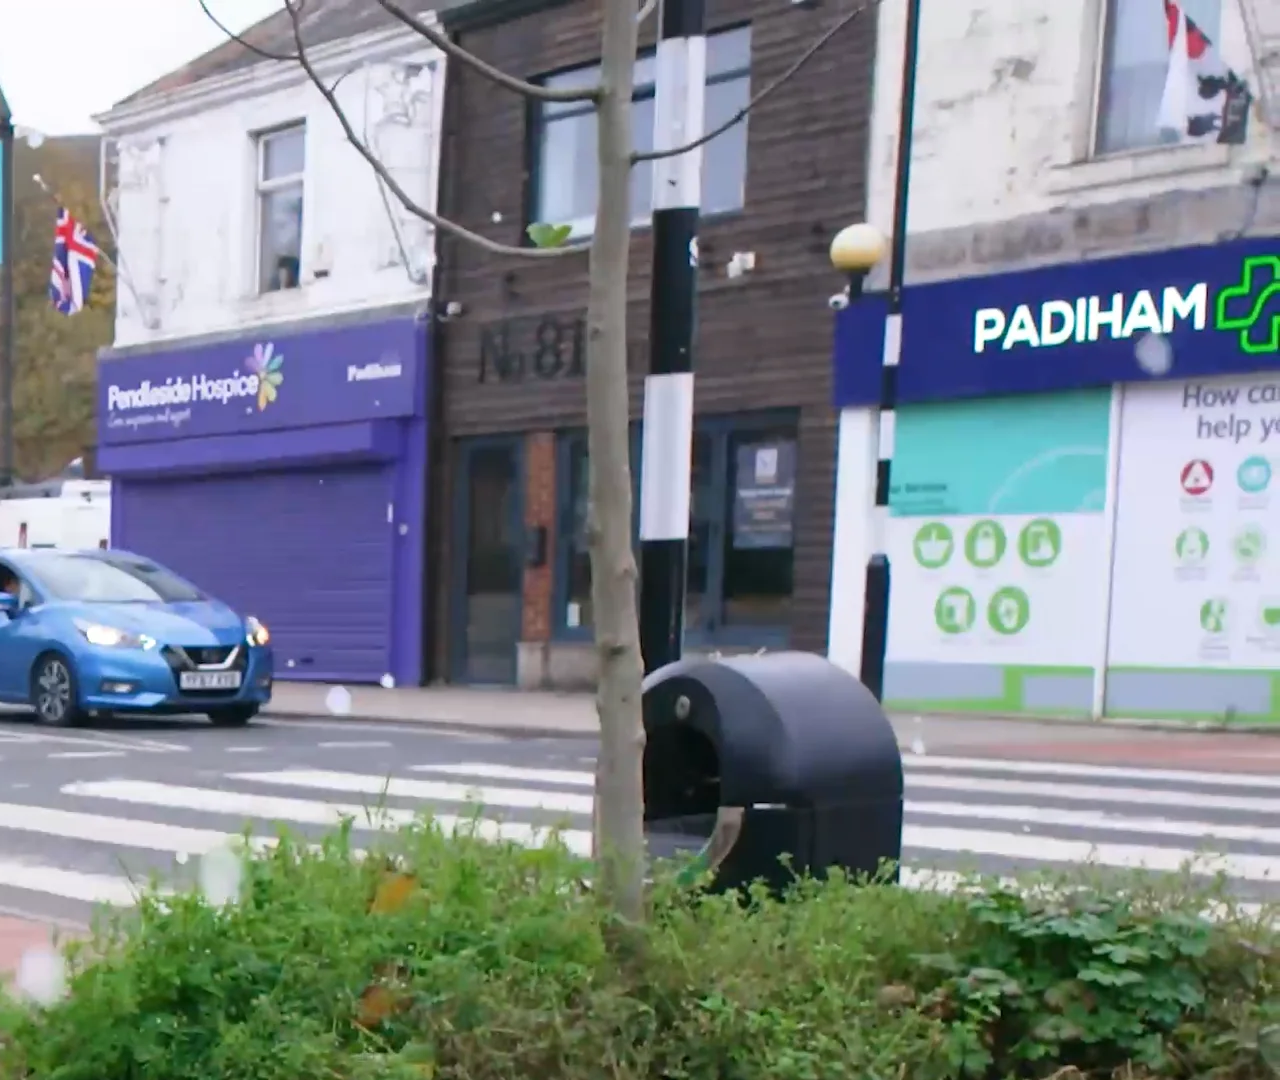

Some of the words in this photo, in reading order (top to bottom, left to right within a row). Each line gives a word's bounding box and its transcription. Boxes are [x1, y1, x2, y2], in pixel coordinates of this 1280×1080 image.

[974, 283, 1207, 353] PADIHAM
[108, 378, 191, 411] Pendleside
[192, 369, 259, 405] Hospice
[1182, 384, 1239, 408] How
[1247, 383, 1280, 404] ca
[1196, 412, 1252, 445] help
